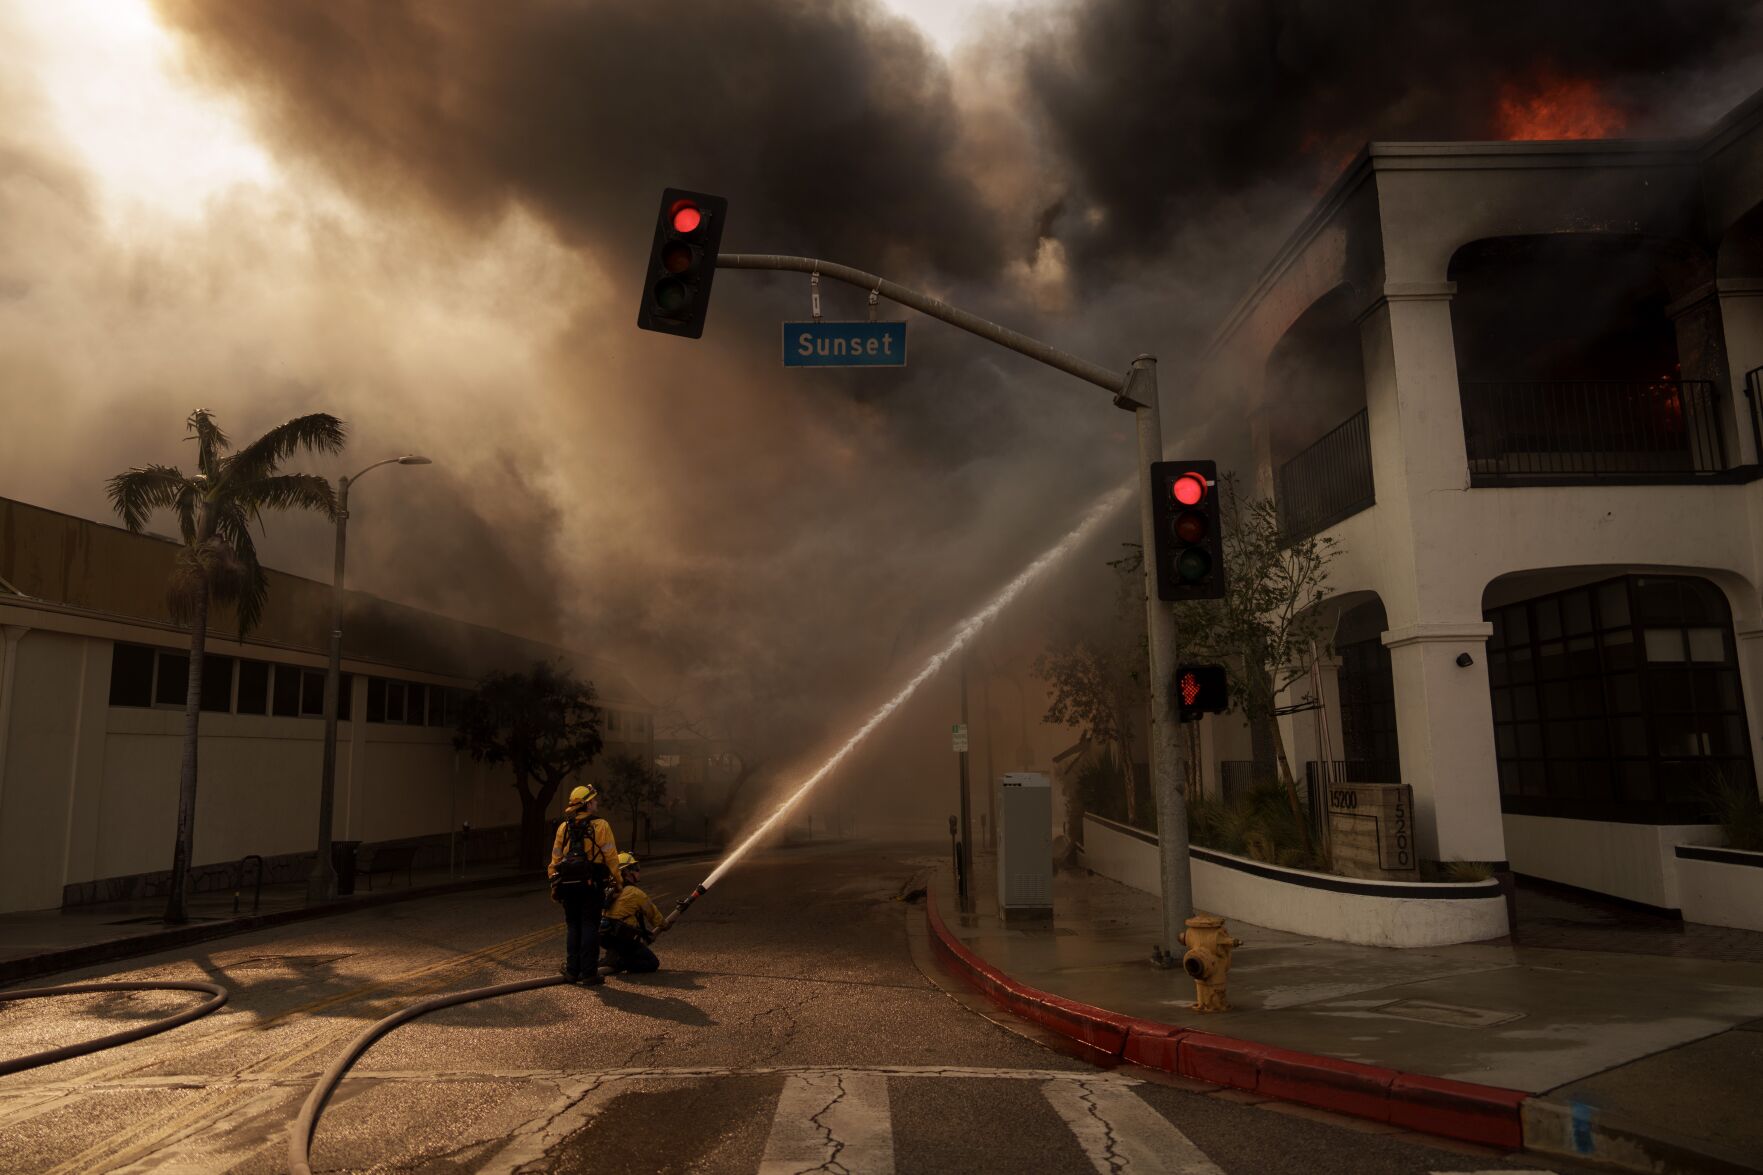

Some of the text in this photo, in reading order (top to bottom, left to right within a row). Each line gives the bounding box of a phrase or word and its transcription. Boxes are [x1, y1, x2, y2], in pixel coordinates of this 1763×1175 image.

[798, 332, 892, 356] Sunset
[1330, 791, 1357, 809] 15200
[1395, 788, 1408, 865] 15200
